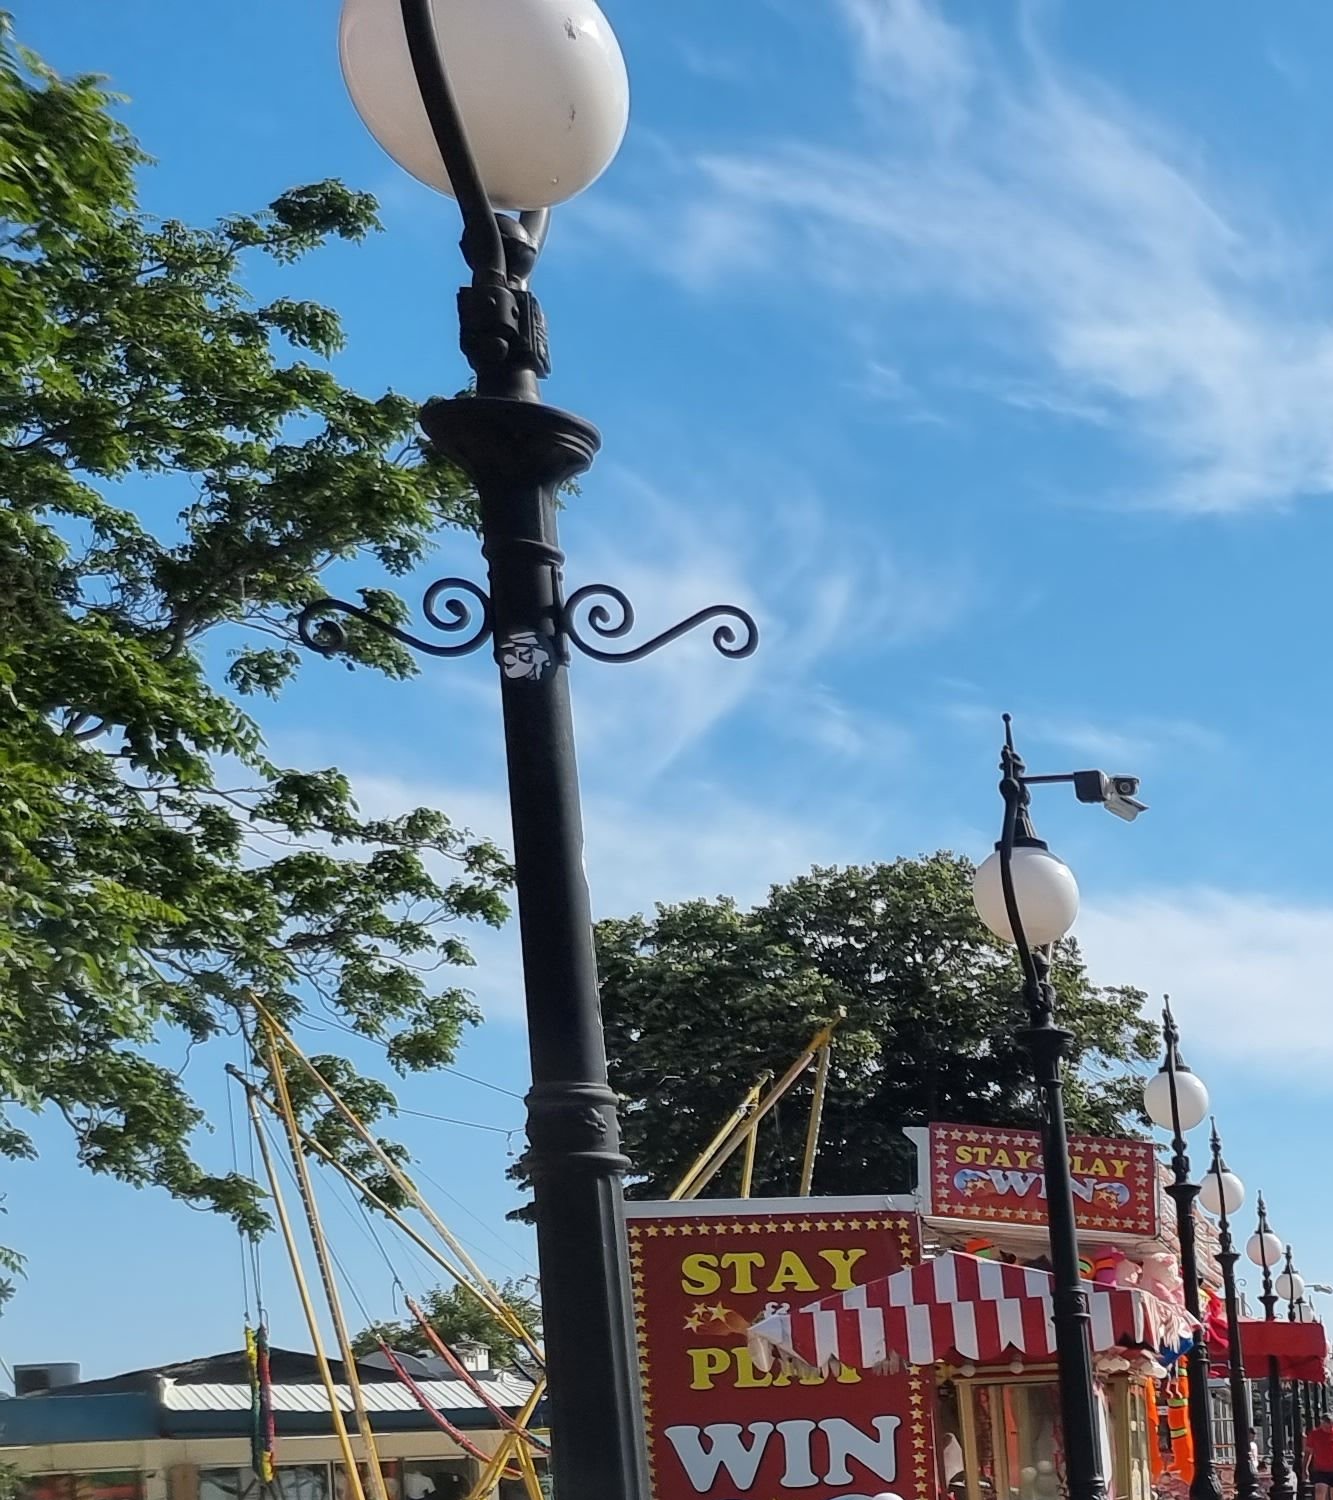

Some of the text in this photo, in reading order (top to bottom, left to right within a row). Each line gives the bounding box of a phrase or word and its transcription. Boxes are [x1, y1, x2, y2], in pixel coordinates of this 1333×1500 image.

[955, 1145, 1034, 1169] STAY
[681, 1248, 868, 1296] STAY
[664, 1415, 902, 1493] WIN
